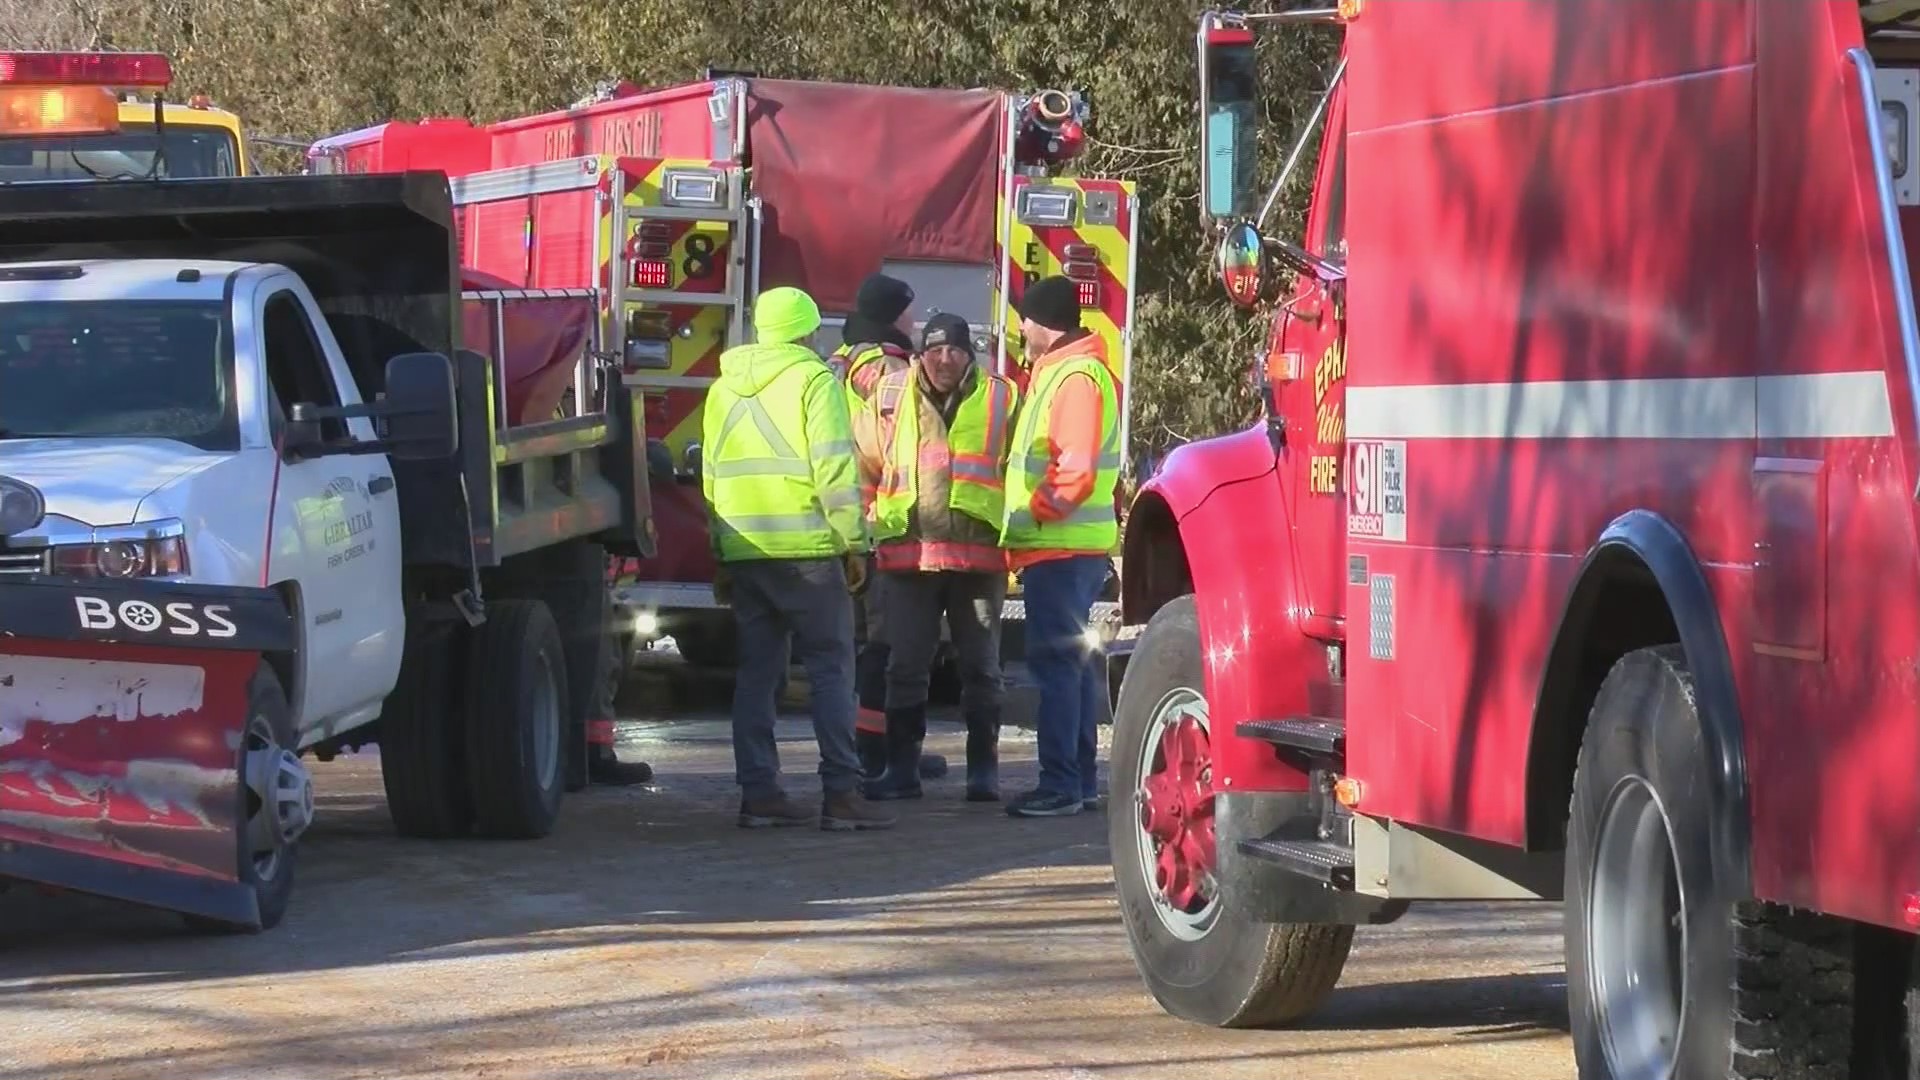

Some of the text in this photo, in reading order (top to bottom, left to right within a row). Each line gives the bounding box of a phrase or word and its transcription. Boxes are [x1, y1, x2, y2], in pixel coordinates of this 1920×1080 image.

[683, 233, 715, 280] 8
[1310, 455, 1337, 493] FIRE
[1384, 448, 1395, 468] FIRE
[1355, 442, 1383, 515] 911
[1384, 471, 1401, 491] POLICE
[1384, 495, 1405, 514] MEDICAL
[323, 510, 374, 546] GIBRALTAR
[74, 596, 237, 637] BOSS
